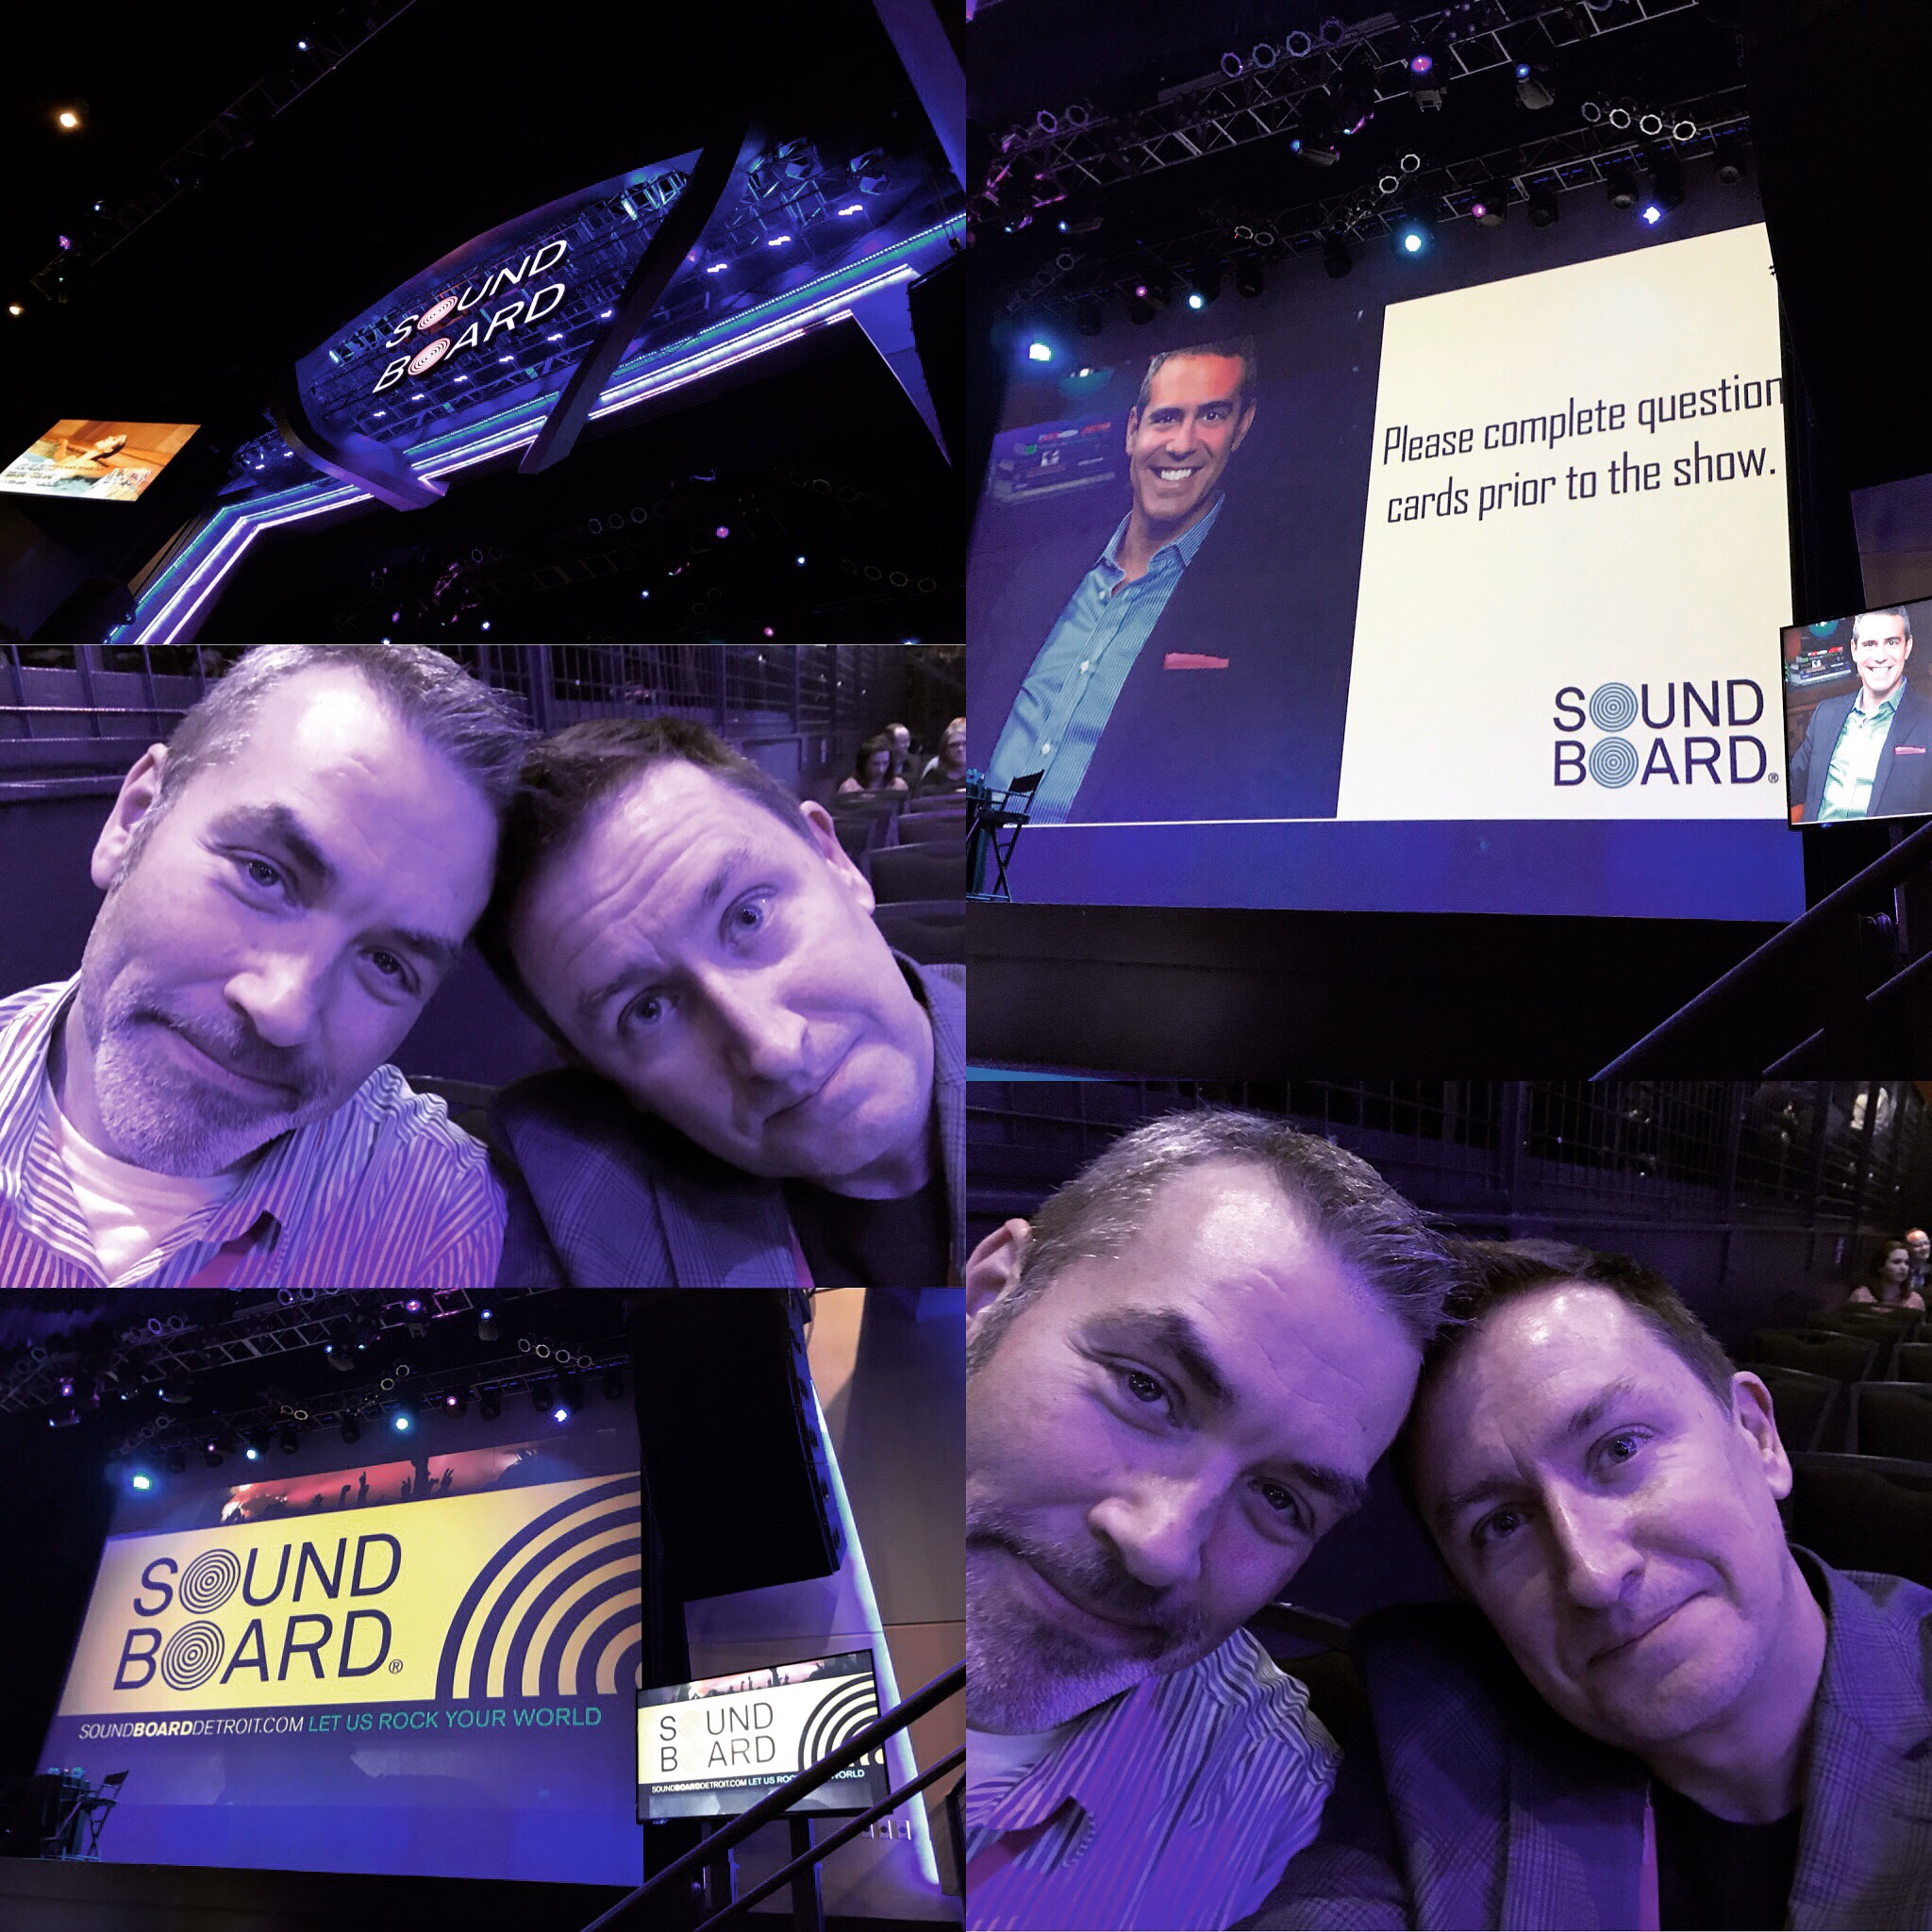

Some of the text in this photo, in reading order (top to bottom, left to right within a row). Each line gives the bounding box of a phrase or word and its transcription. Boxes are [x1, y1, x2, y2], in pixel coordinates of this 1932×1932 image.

[386, 240, 567, 348] SOUND
[372, 283, 566, 393] BOARD
[1383, 374, 1784, 464] Please complete question
[1387, 441, 1776, 523] cards prior to the show.
[1553, 678, 1765, 733] SOUND
[133, 1533, 403, 1617] SOUND
[78, 1706, 603, 1740] SOUNDBOARDDETROIT.COM LET US ROCK YOUR WORLD
[747, 1776, 762, 1786] LET
[763, 1775, 775, 1785] US
